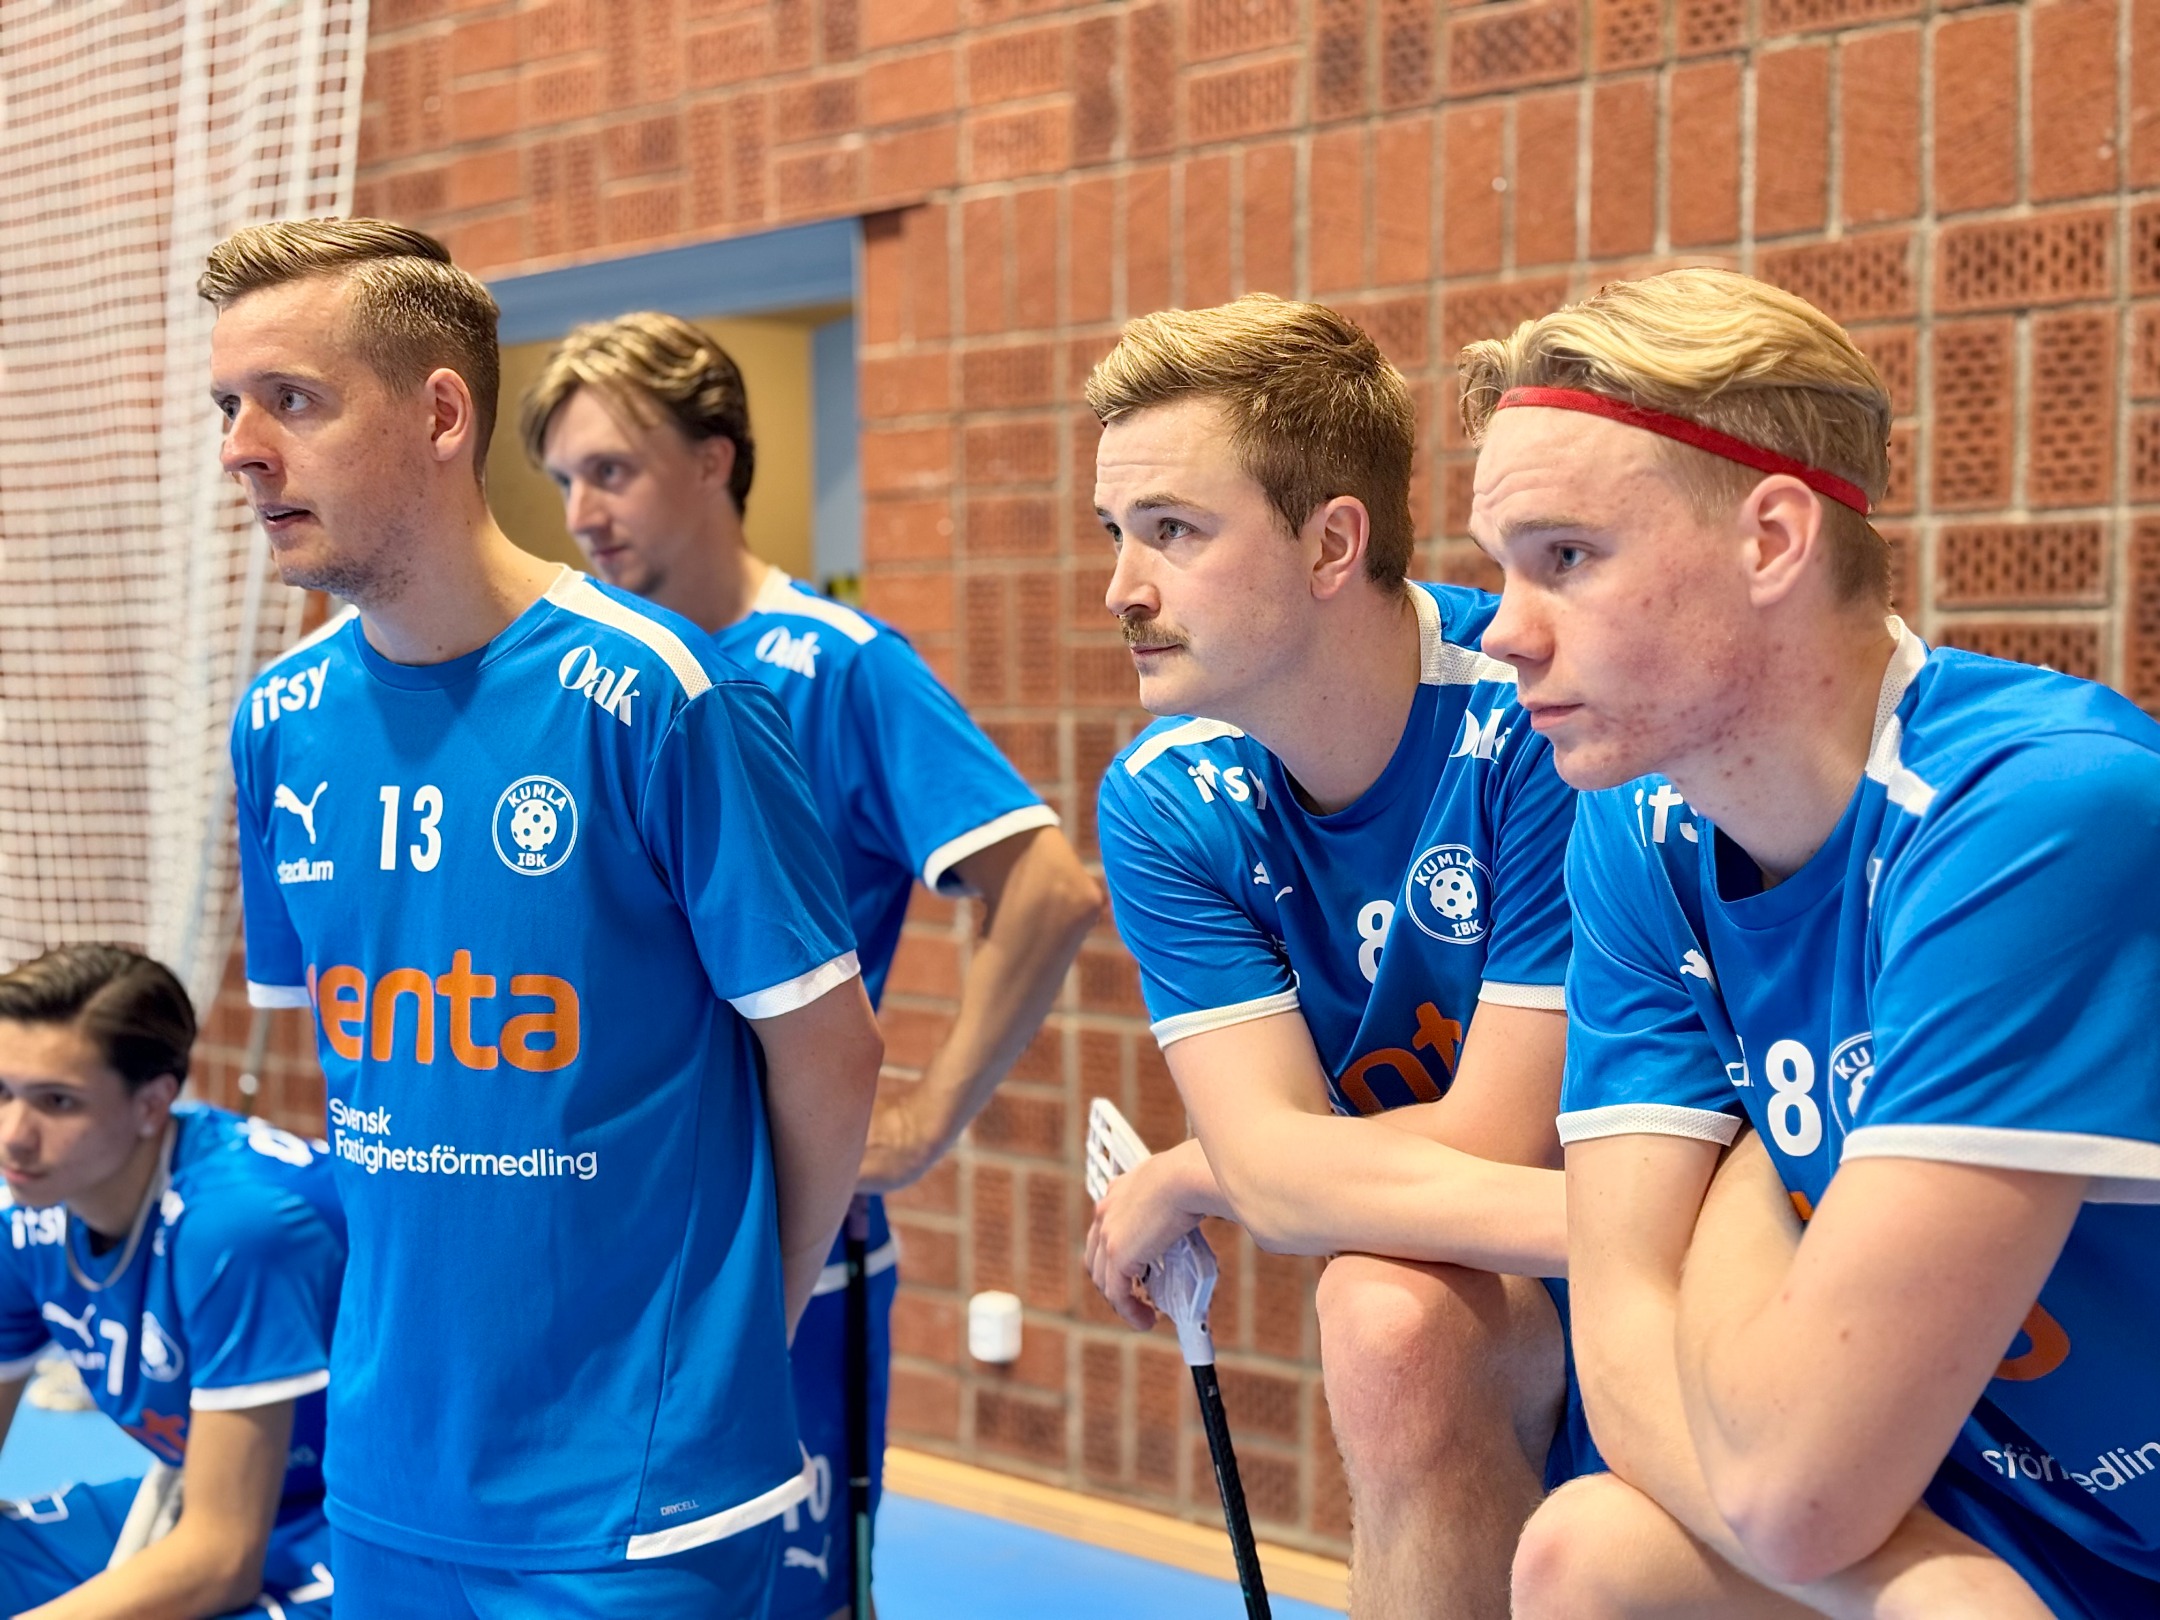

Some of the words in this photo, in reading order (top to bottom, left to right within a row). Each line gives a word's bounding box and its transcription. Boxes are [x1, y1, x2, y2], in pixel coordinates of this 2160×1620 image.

[251, 657, 330, 730] itsy
[558, 645, 641, 727] Oak
[507, 783, 567, 812] KUMLA
[379, 784, 444, 872] 13
[276, 857, 334, 884] stadium
[517, 852, 547, 867] IBK
[1415, 851, 1475, 887] KUMLA
[1357, 899, 1396, 984] 8
[1451, 919, 1484, 938] IBK
[329, 1097, 392, 1136] Svensk
[1765, 1039, 1823, 1157] 8
[334, 1128, 599, 1180] Fastighetsförmedling
[660, 1499, 700, 1517] DRYCELL
